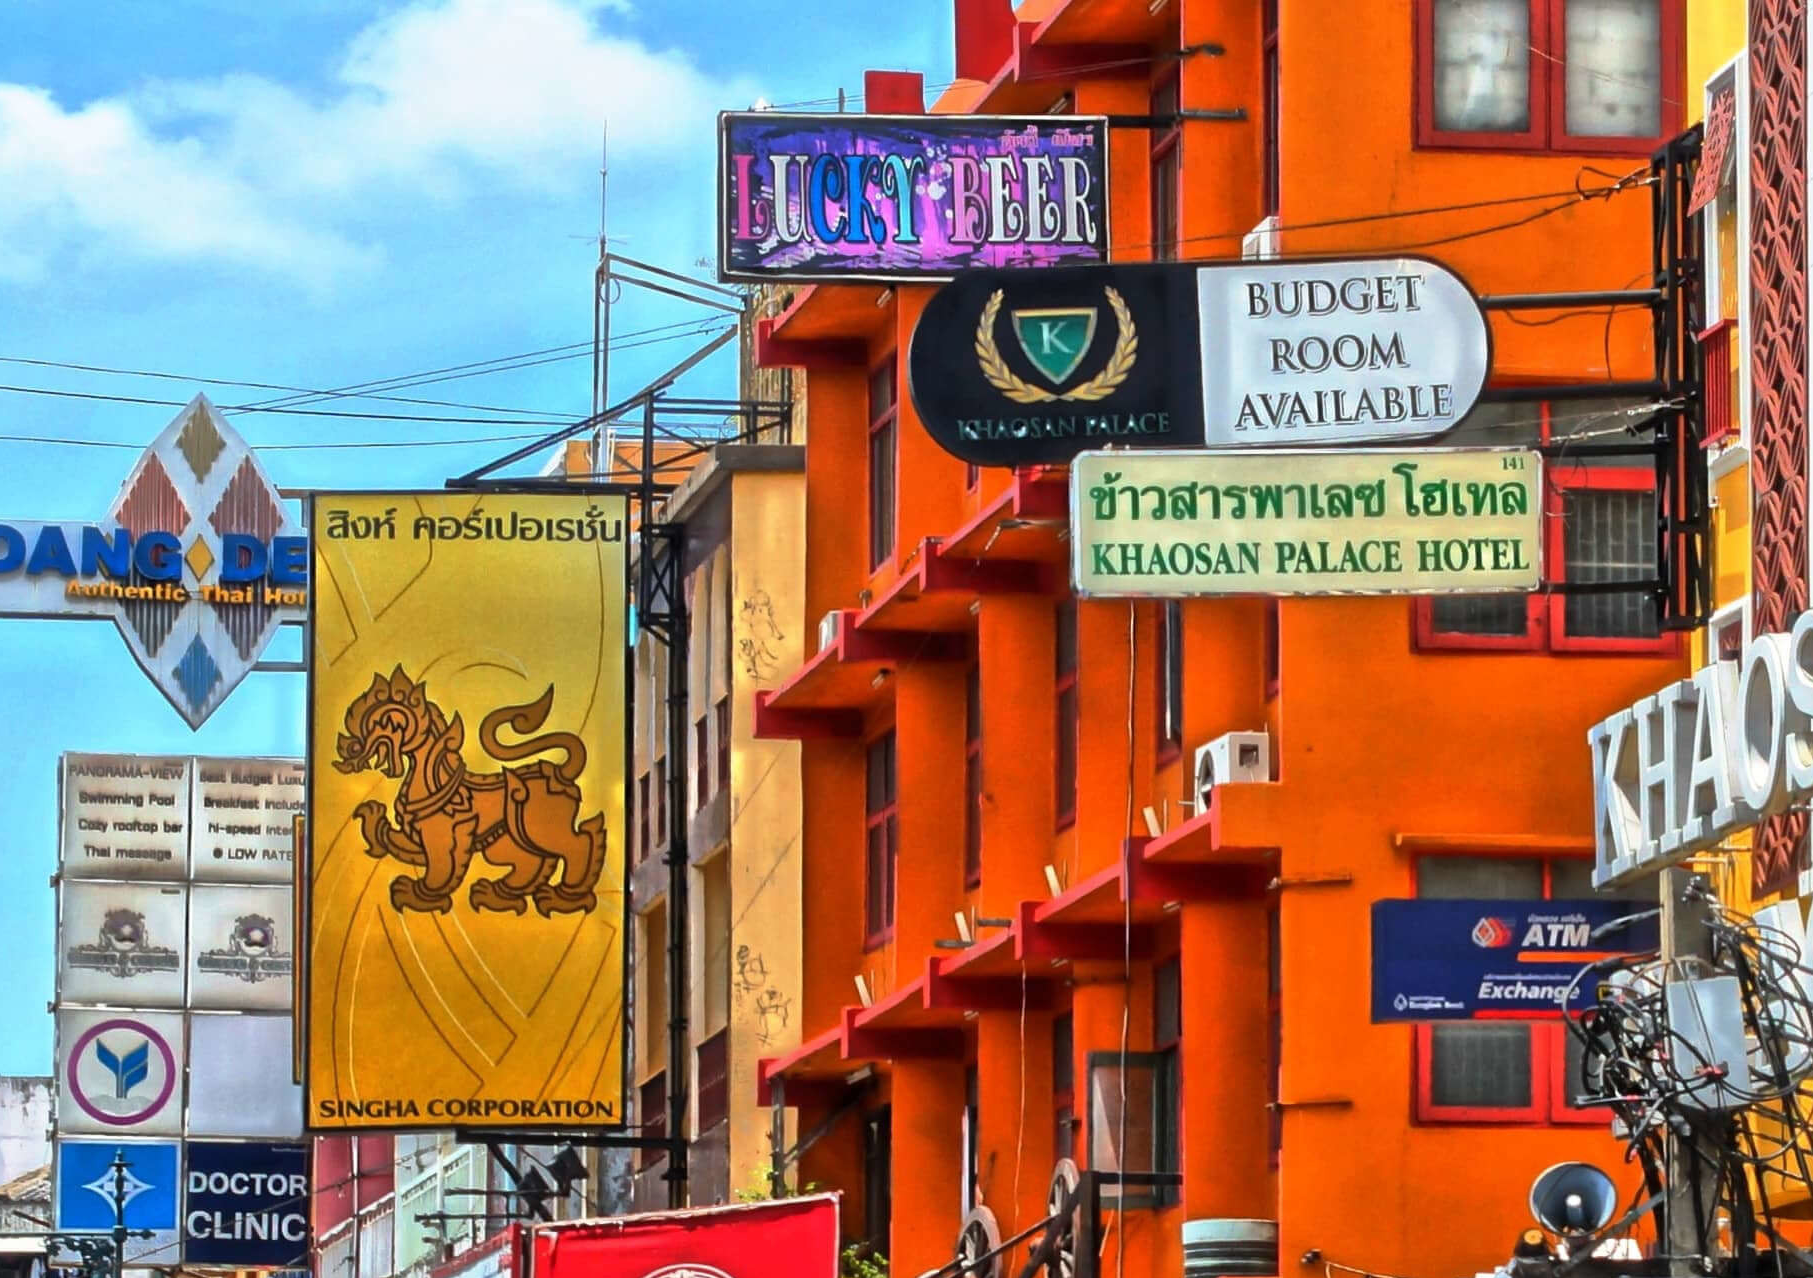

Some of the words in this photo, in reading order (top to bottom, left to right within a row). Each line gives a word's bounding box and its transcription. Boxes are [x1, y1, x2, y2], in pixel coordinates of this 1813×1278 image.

[732, 151, 926, 245] LUCKY
[949, 152, 1098, 245] BEER
[1247, 275, 1423, 318] BUDGET
[1039, 320, 1074, 356] K
[1269, 332, 1410, 374] ROOM
[1235, 385, 1456, 432] AVAILABLE
[957, 415, 1078, 441] KHAOSAN
[1087, 412, 1172, 436] PALACE
[1502, 457, 1526, 471] 141
[1089, 471, 1386, 523] ข้าวสารพาเลซ
[1393, 463, 1529, 517] โฮเทล
[326, 507, 396, 541] สิงห์
[413, 504, 623, 544] คอร์เปอเรชั่น
[219, 532, 308, 584] DE
[1092, 543, 1261, 577] KHAOSAN
[1275, 541, 1403, 575] PALACE
[1418, 538, 1530, 572] HOTEL
[65, 578, 186, 603] Authentic
[202, 584, 253, 604] Thai
[68, 764, 184, 781] PANORAMA-VIEW
[200, 766, 225, 783] Best
[231, 768, 273, 787] Budget
[277, 770, 306, 786] Luxu
[78, 791, 144, 808] Swimming
[148, 793, 175, 807] Pool
[203, 796, 260, 810] Breakfast
[78, 818, 108, 833] Cozy
[112, 819, 158, 834] rooftop
[163, 820, 184, 833] bar
[208, 822, 262, 836] hi-speed
[83, 844, 111, 858] Thai
[227, 847, 258, 861] LOW
[262, 849, 293, 862] RATE
[1521, 924, 1591, 947] ATM
[1478, 981, 1581, 1004] Exchange
[319, 1099, 420, 1120] SINGHA
[426, 1099, 615, 1120] CORPORATION
[188, 1170, 308, 1199] DOCTOR
[187, 1209, 307, 1244] CLINIC
